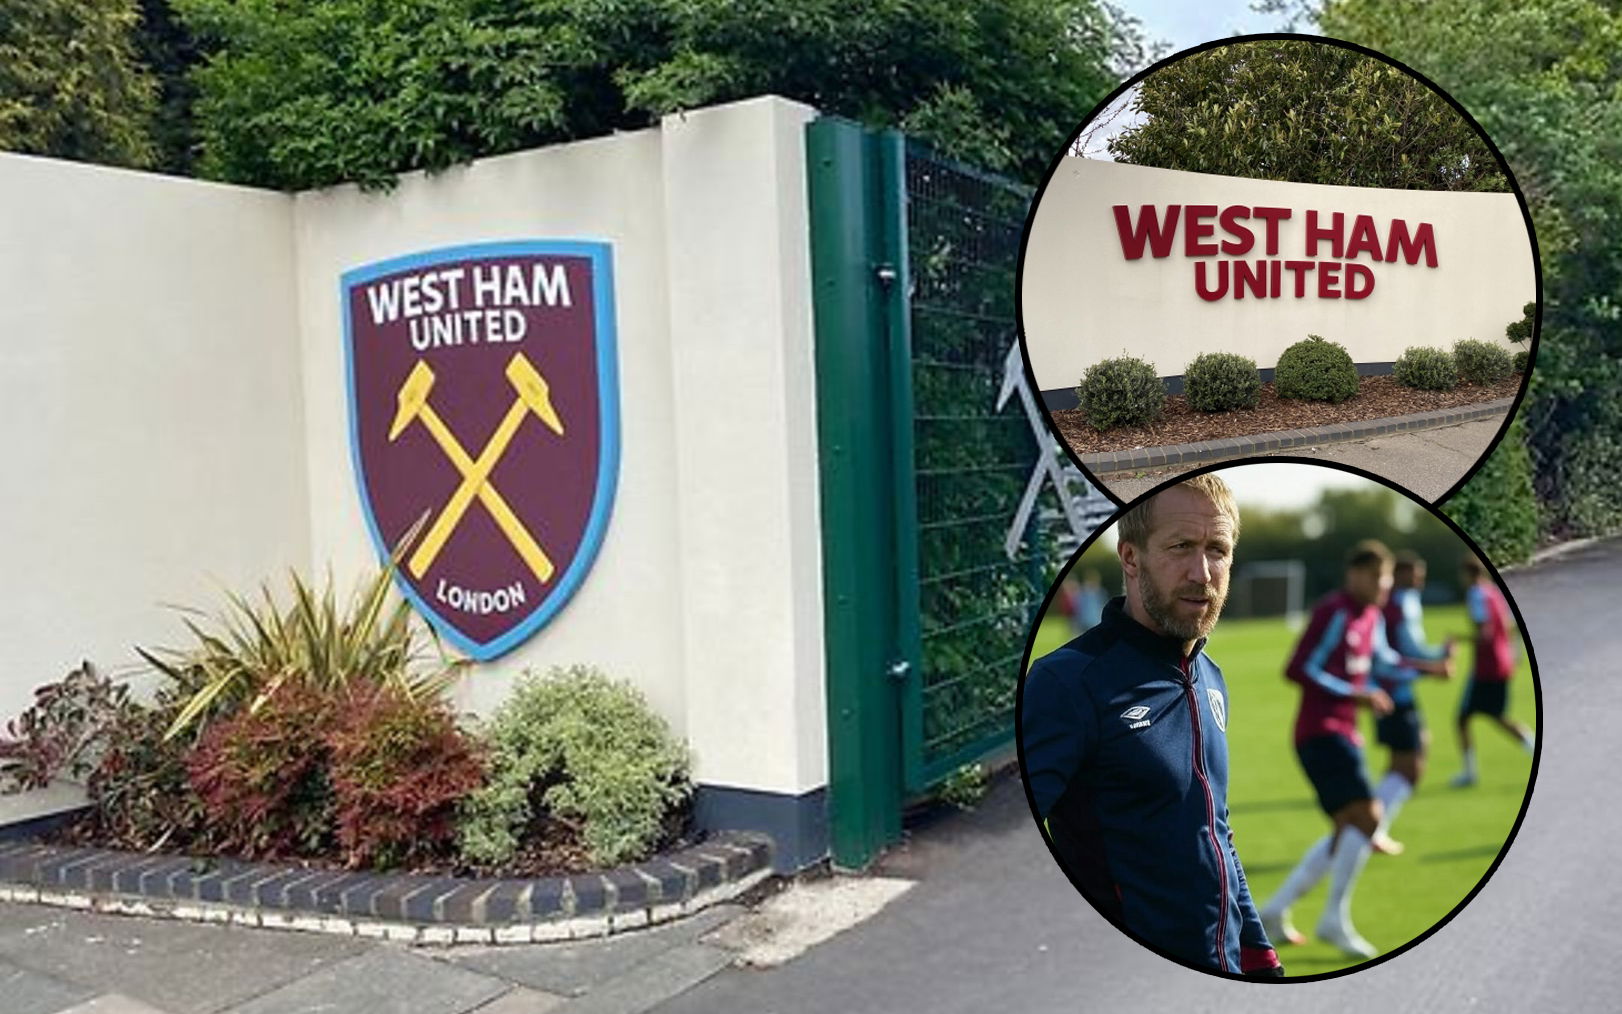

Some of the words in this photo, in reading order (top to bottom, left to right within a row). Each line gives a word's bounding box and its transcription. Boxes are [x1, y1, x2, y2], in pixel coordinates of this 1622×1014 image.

[1112, 204, 1292, 261] WEST
[1305, 209, 1438, 268] HAM
[368, 269, 464, 324] WEST
[472, 264, 571, 309] HAM
[1194, 260, 1376, 302] UNITED
[409, 310, 527, 351] UNITED
[436, 579, 526, 615] LONDON
